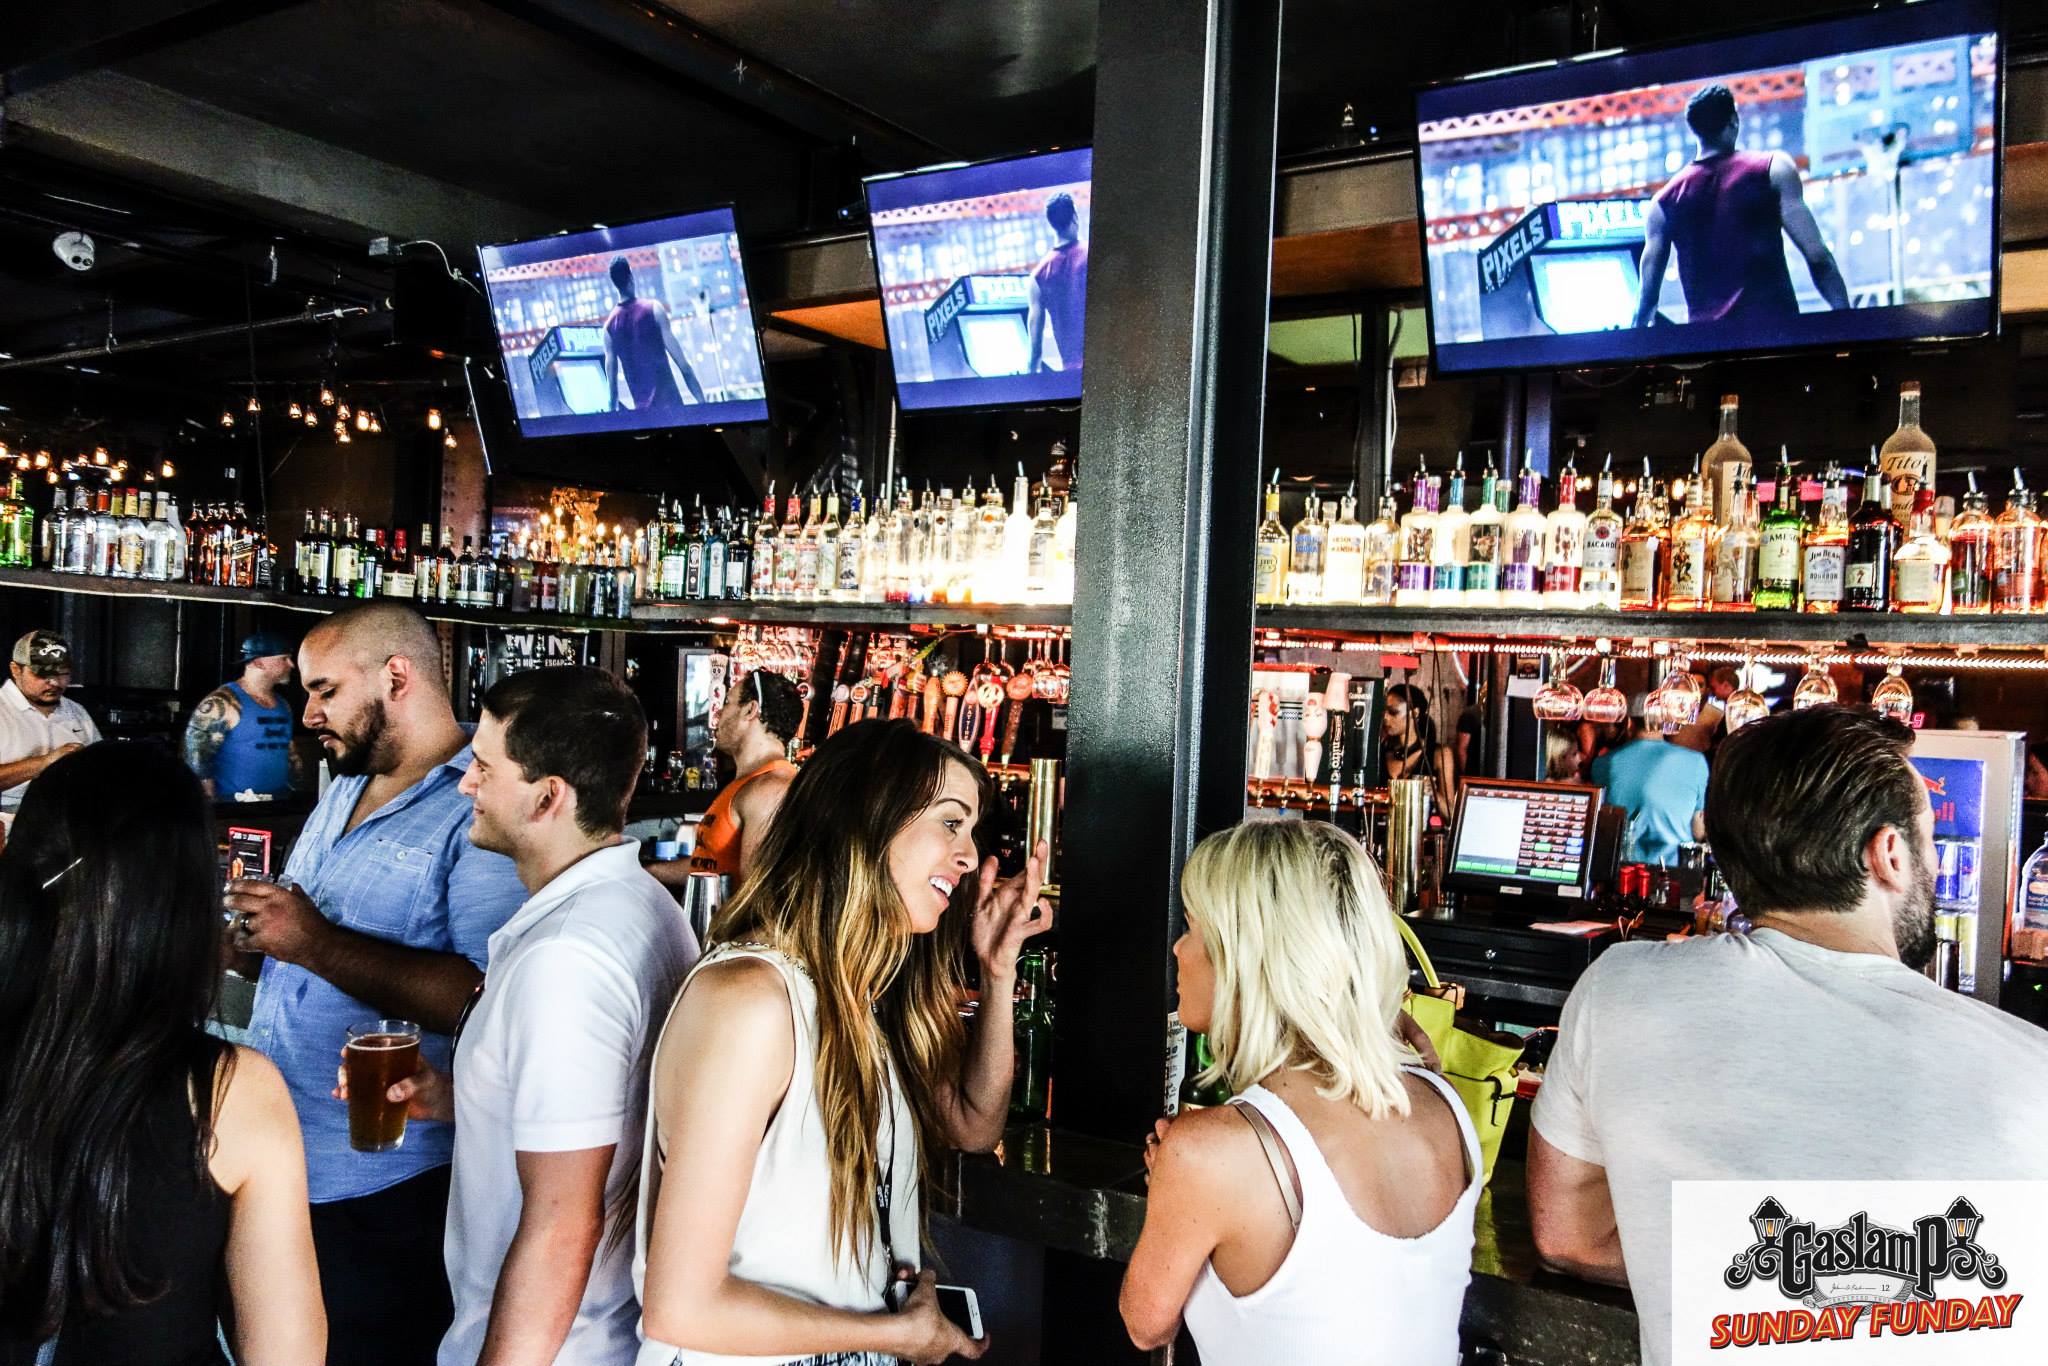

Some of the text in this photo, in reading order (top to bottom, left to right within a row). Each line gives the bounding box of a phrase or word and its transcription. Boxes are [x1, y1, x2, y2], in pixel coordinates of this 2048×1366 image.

[1482, 214, 1545, 288] PIXELS
[926, 284, 966, 341] PIXELS
[531, 334, 558, 380] PIXELS
[1587, 541, 1617, 549] BACARDI
[545, 658, 569, 668] ESCAP
